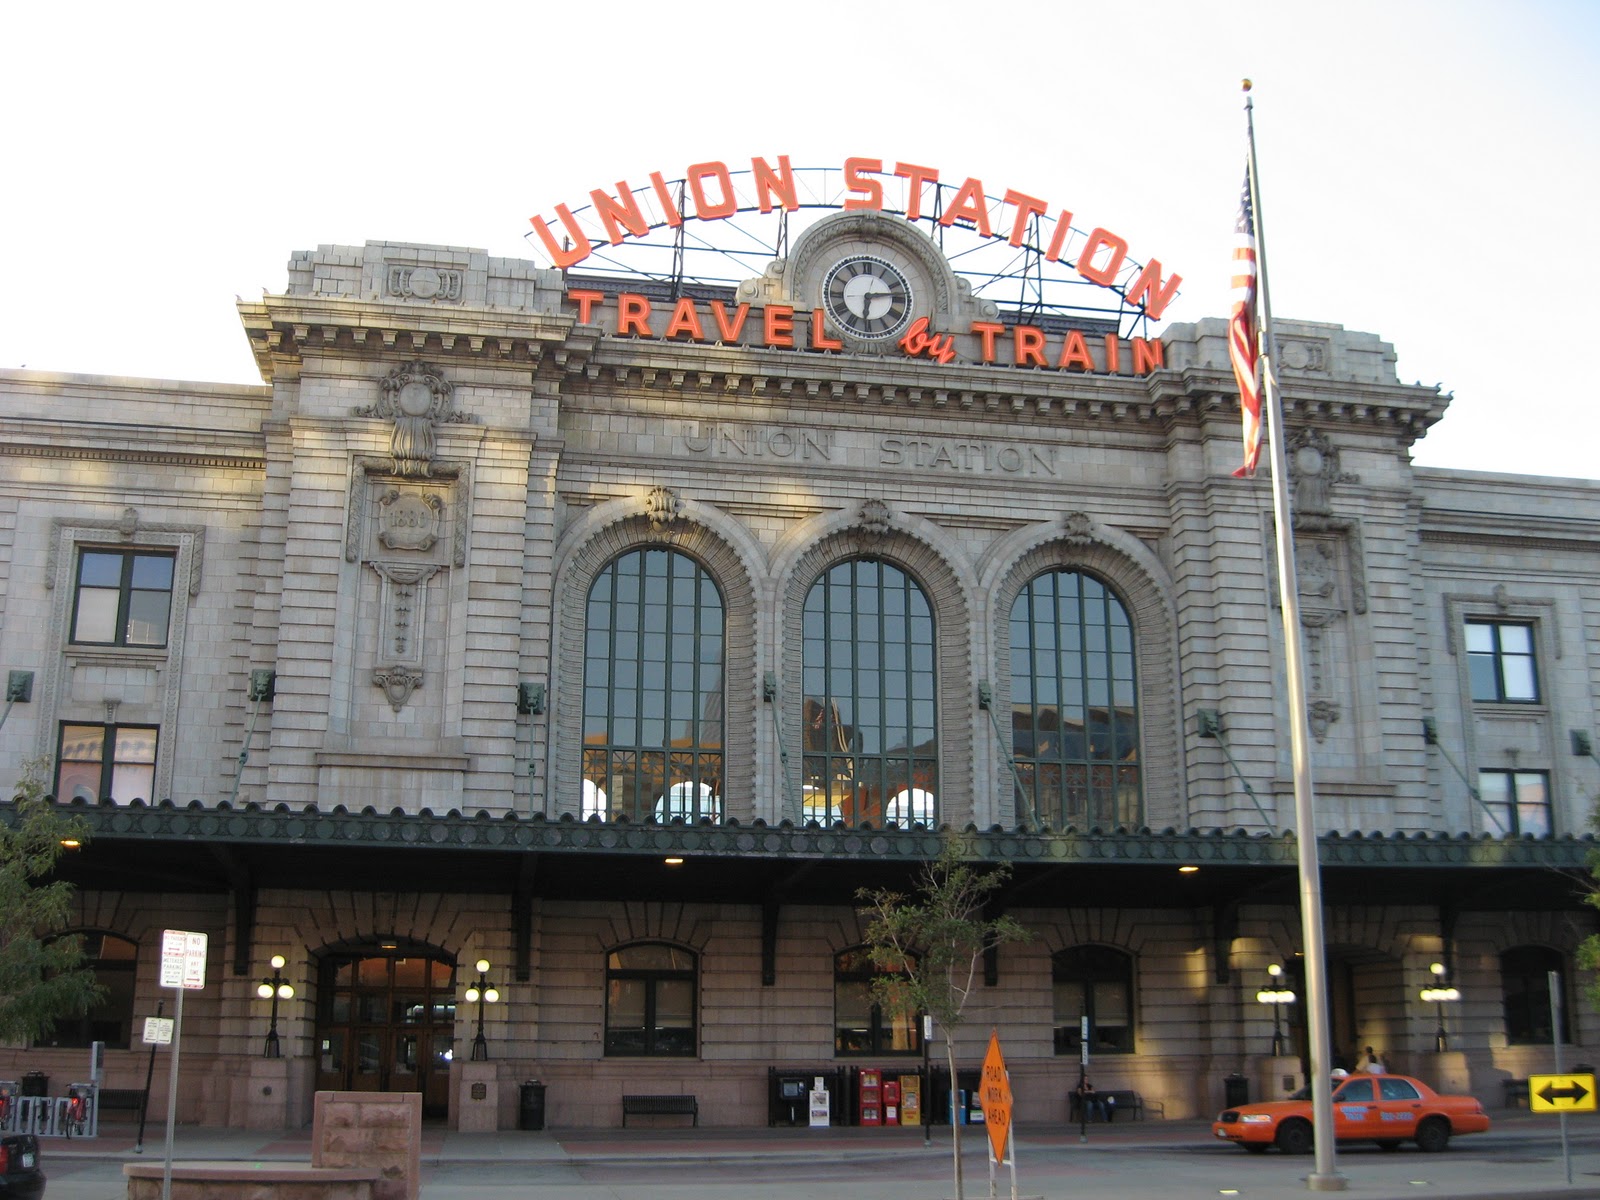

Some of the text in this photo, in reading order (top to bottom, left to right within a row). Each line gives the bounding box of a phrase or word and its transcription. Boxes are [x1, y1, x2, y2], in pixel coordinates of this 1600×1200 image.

[529, 154, 1182, 322] UNION STATION
[567, 288, 1164, 374] TRAVEL by TRAIN
[683, 424, 1057, 476] UNION STATION
[191, 937, 201, 946] NO
[186, 949, 205, 958] PARKING
[986, 1065, 1001, 1082] ROAD
[987, 1087, 1003, 1104] WORK
[987, 1108, 1006, 1126] AHEAD
